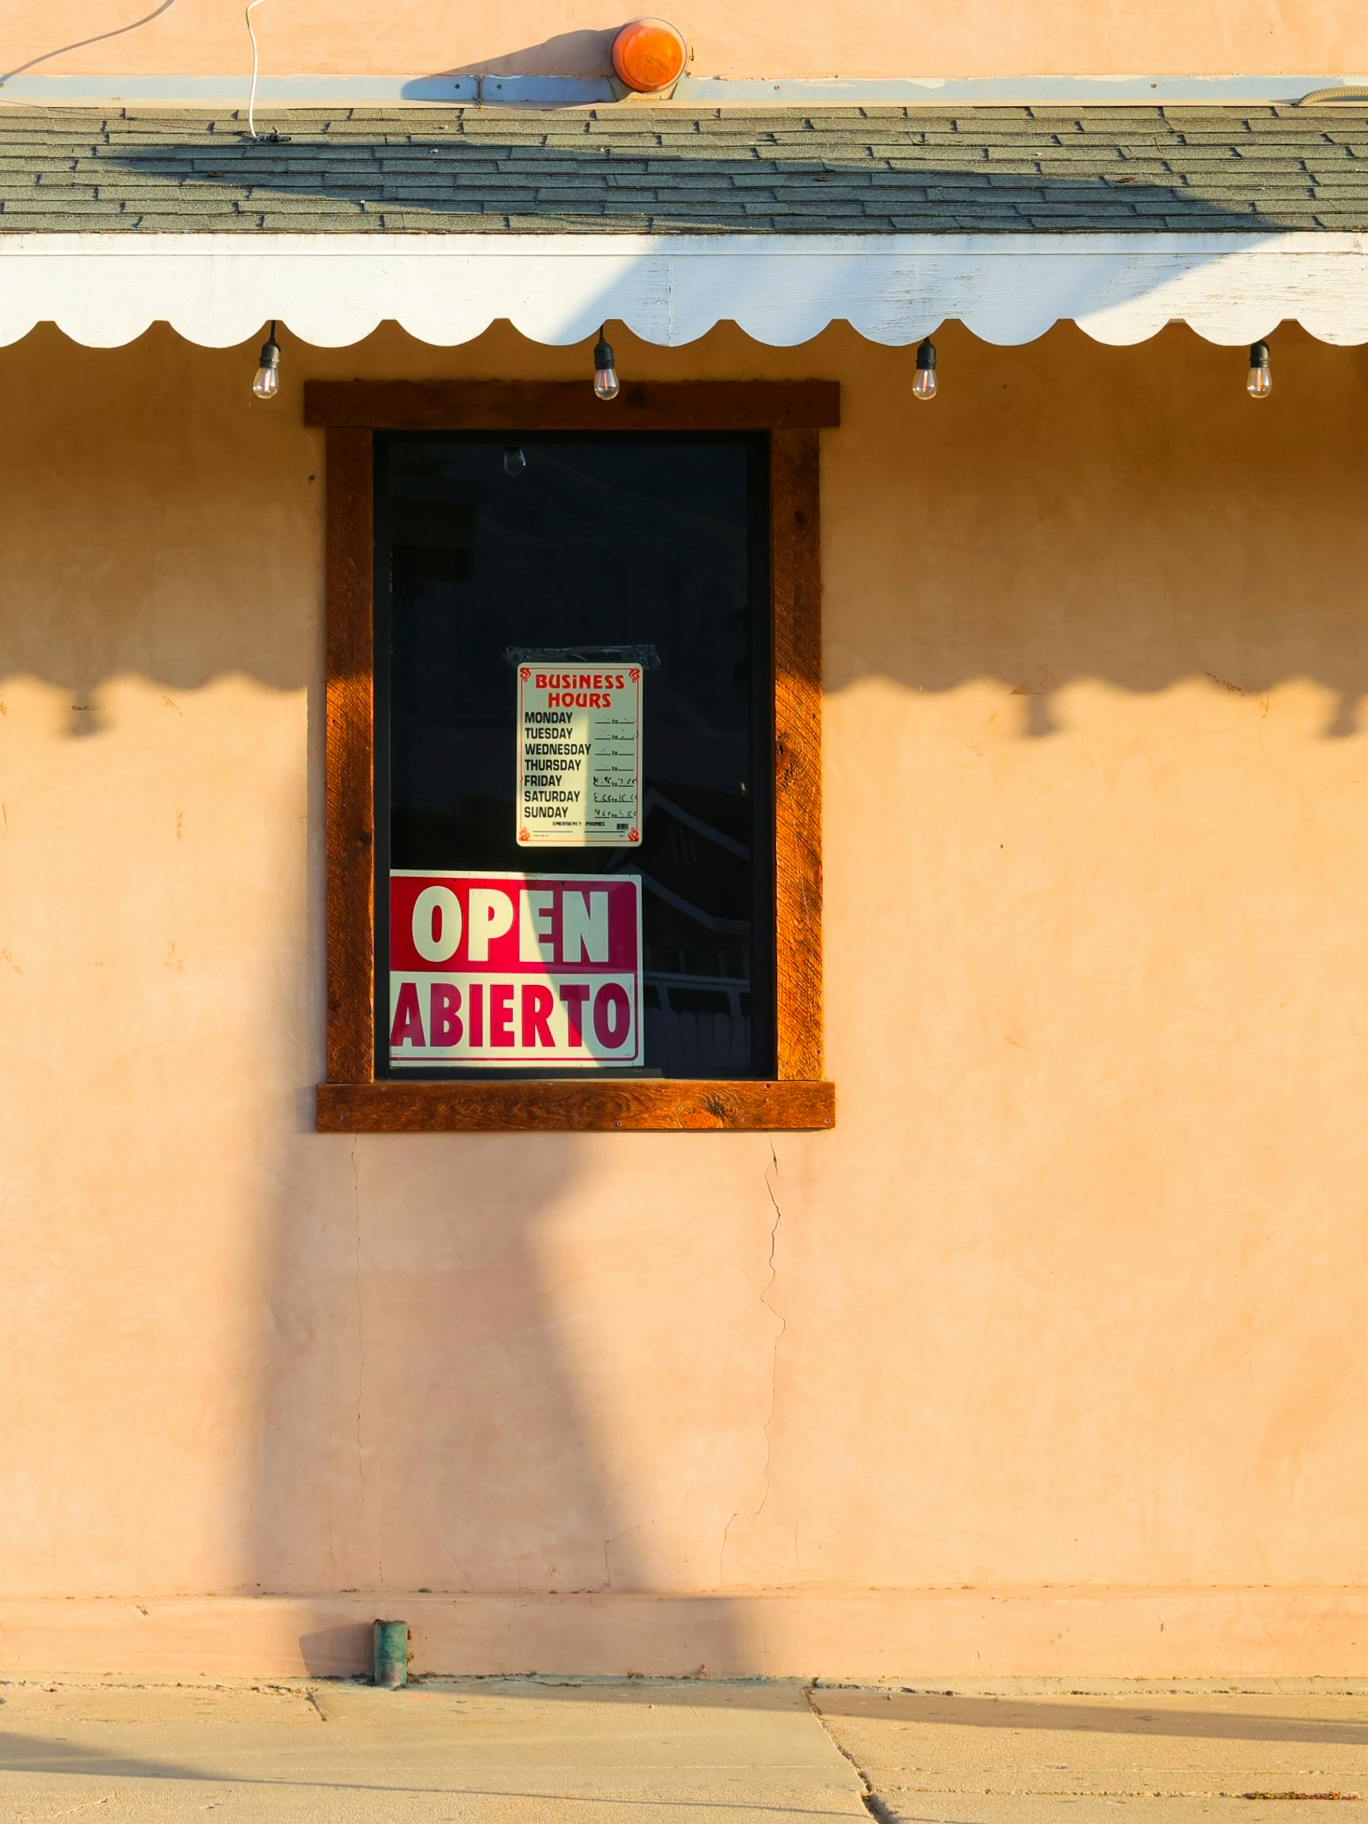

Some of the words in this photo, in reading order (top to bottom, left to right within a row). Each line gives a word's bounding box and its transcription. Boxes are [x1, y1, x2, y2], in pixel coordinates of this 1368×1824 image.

[548, 693, 613, 709] HOURS
[524, 711, 574, 724] MONDAY
[525, 727, 574, 740] TUESDAY
[525, 743, 592, 756] WEDNESDAY
[524, 759, 582, 771] THURSDAY
[524, 775, 563, 787] FRIDAY
[524, 791, 581, 803] SATURDAY
[524, 806, 569, 818] SUNDAY
[411, 885, 609, 963] OPEN
[390, 982, 631, 1049] ABIERTO
